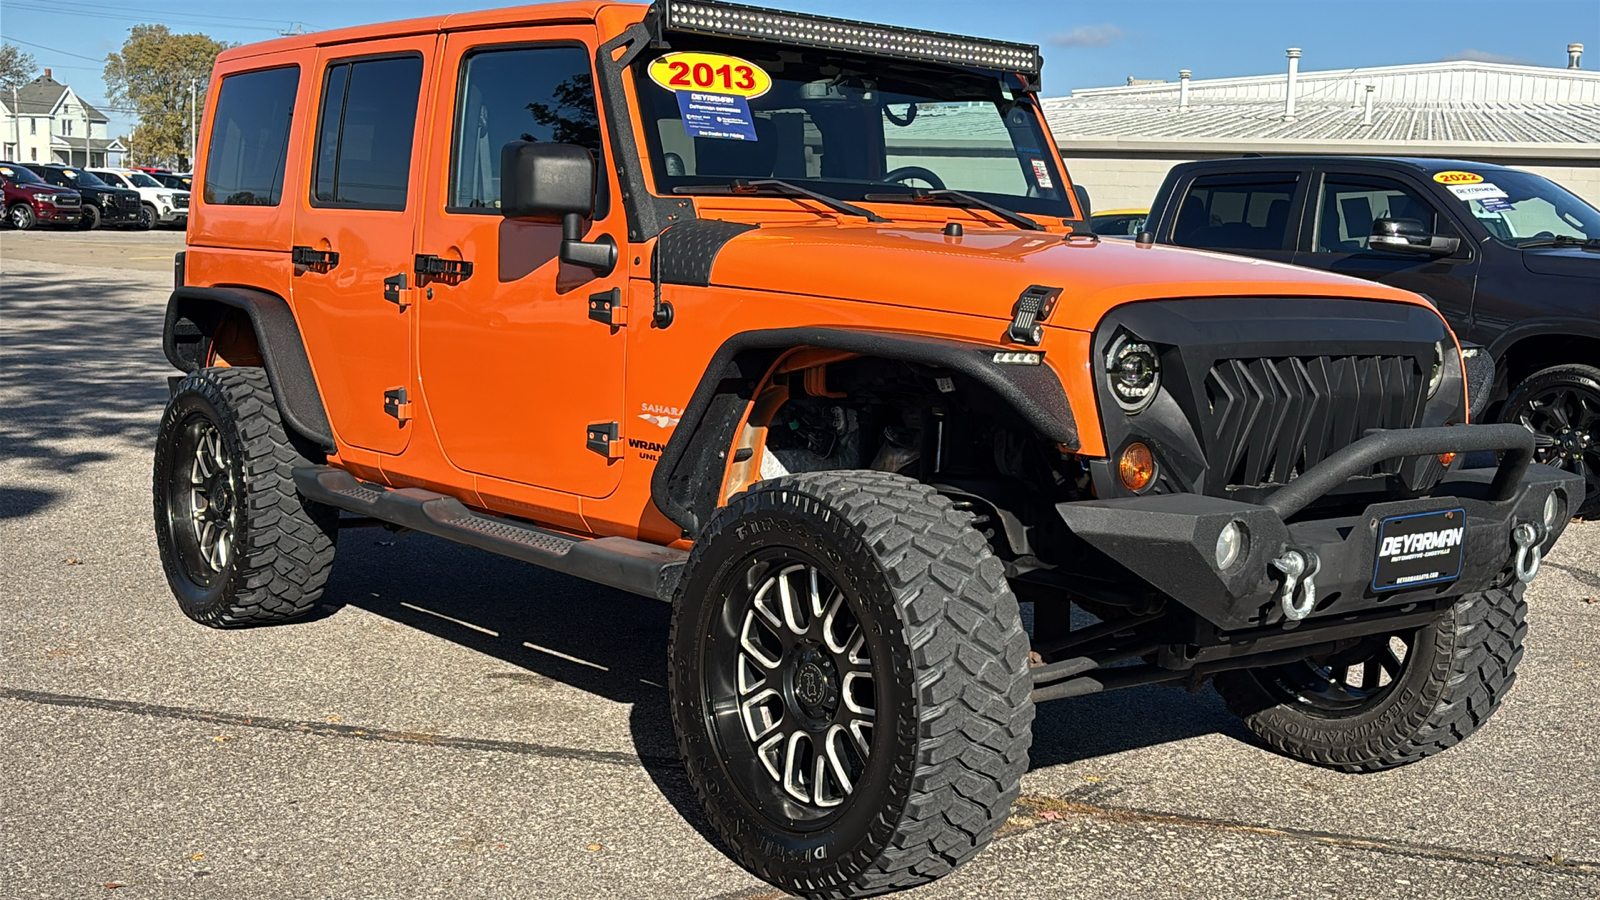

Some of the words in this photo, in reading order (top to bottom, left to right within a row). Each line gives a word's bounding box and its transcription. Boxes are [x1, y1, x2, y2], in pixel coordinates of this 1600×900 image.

[668, 61, 756, 91] 2013
[691, 93, 734, 104] DEYARMAN
[1440, 173, 1480, 182] 2022
[1456, 186, 1497, 194] DEYARMAN
[628, 438, 667, 452] WRAN
[639, 452, 661, 462] UNL
[1379, 527, 1464, 557] DEYARMAN
[1267, 687, 1415, 745] DESTINATION
